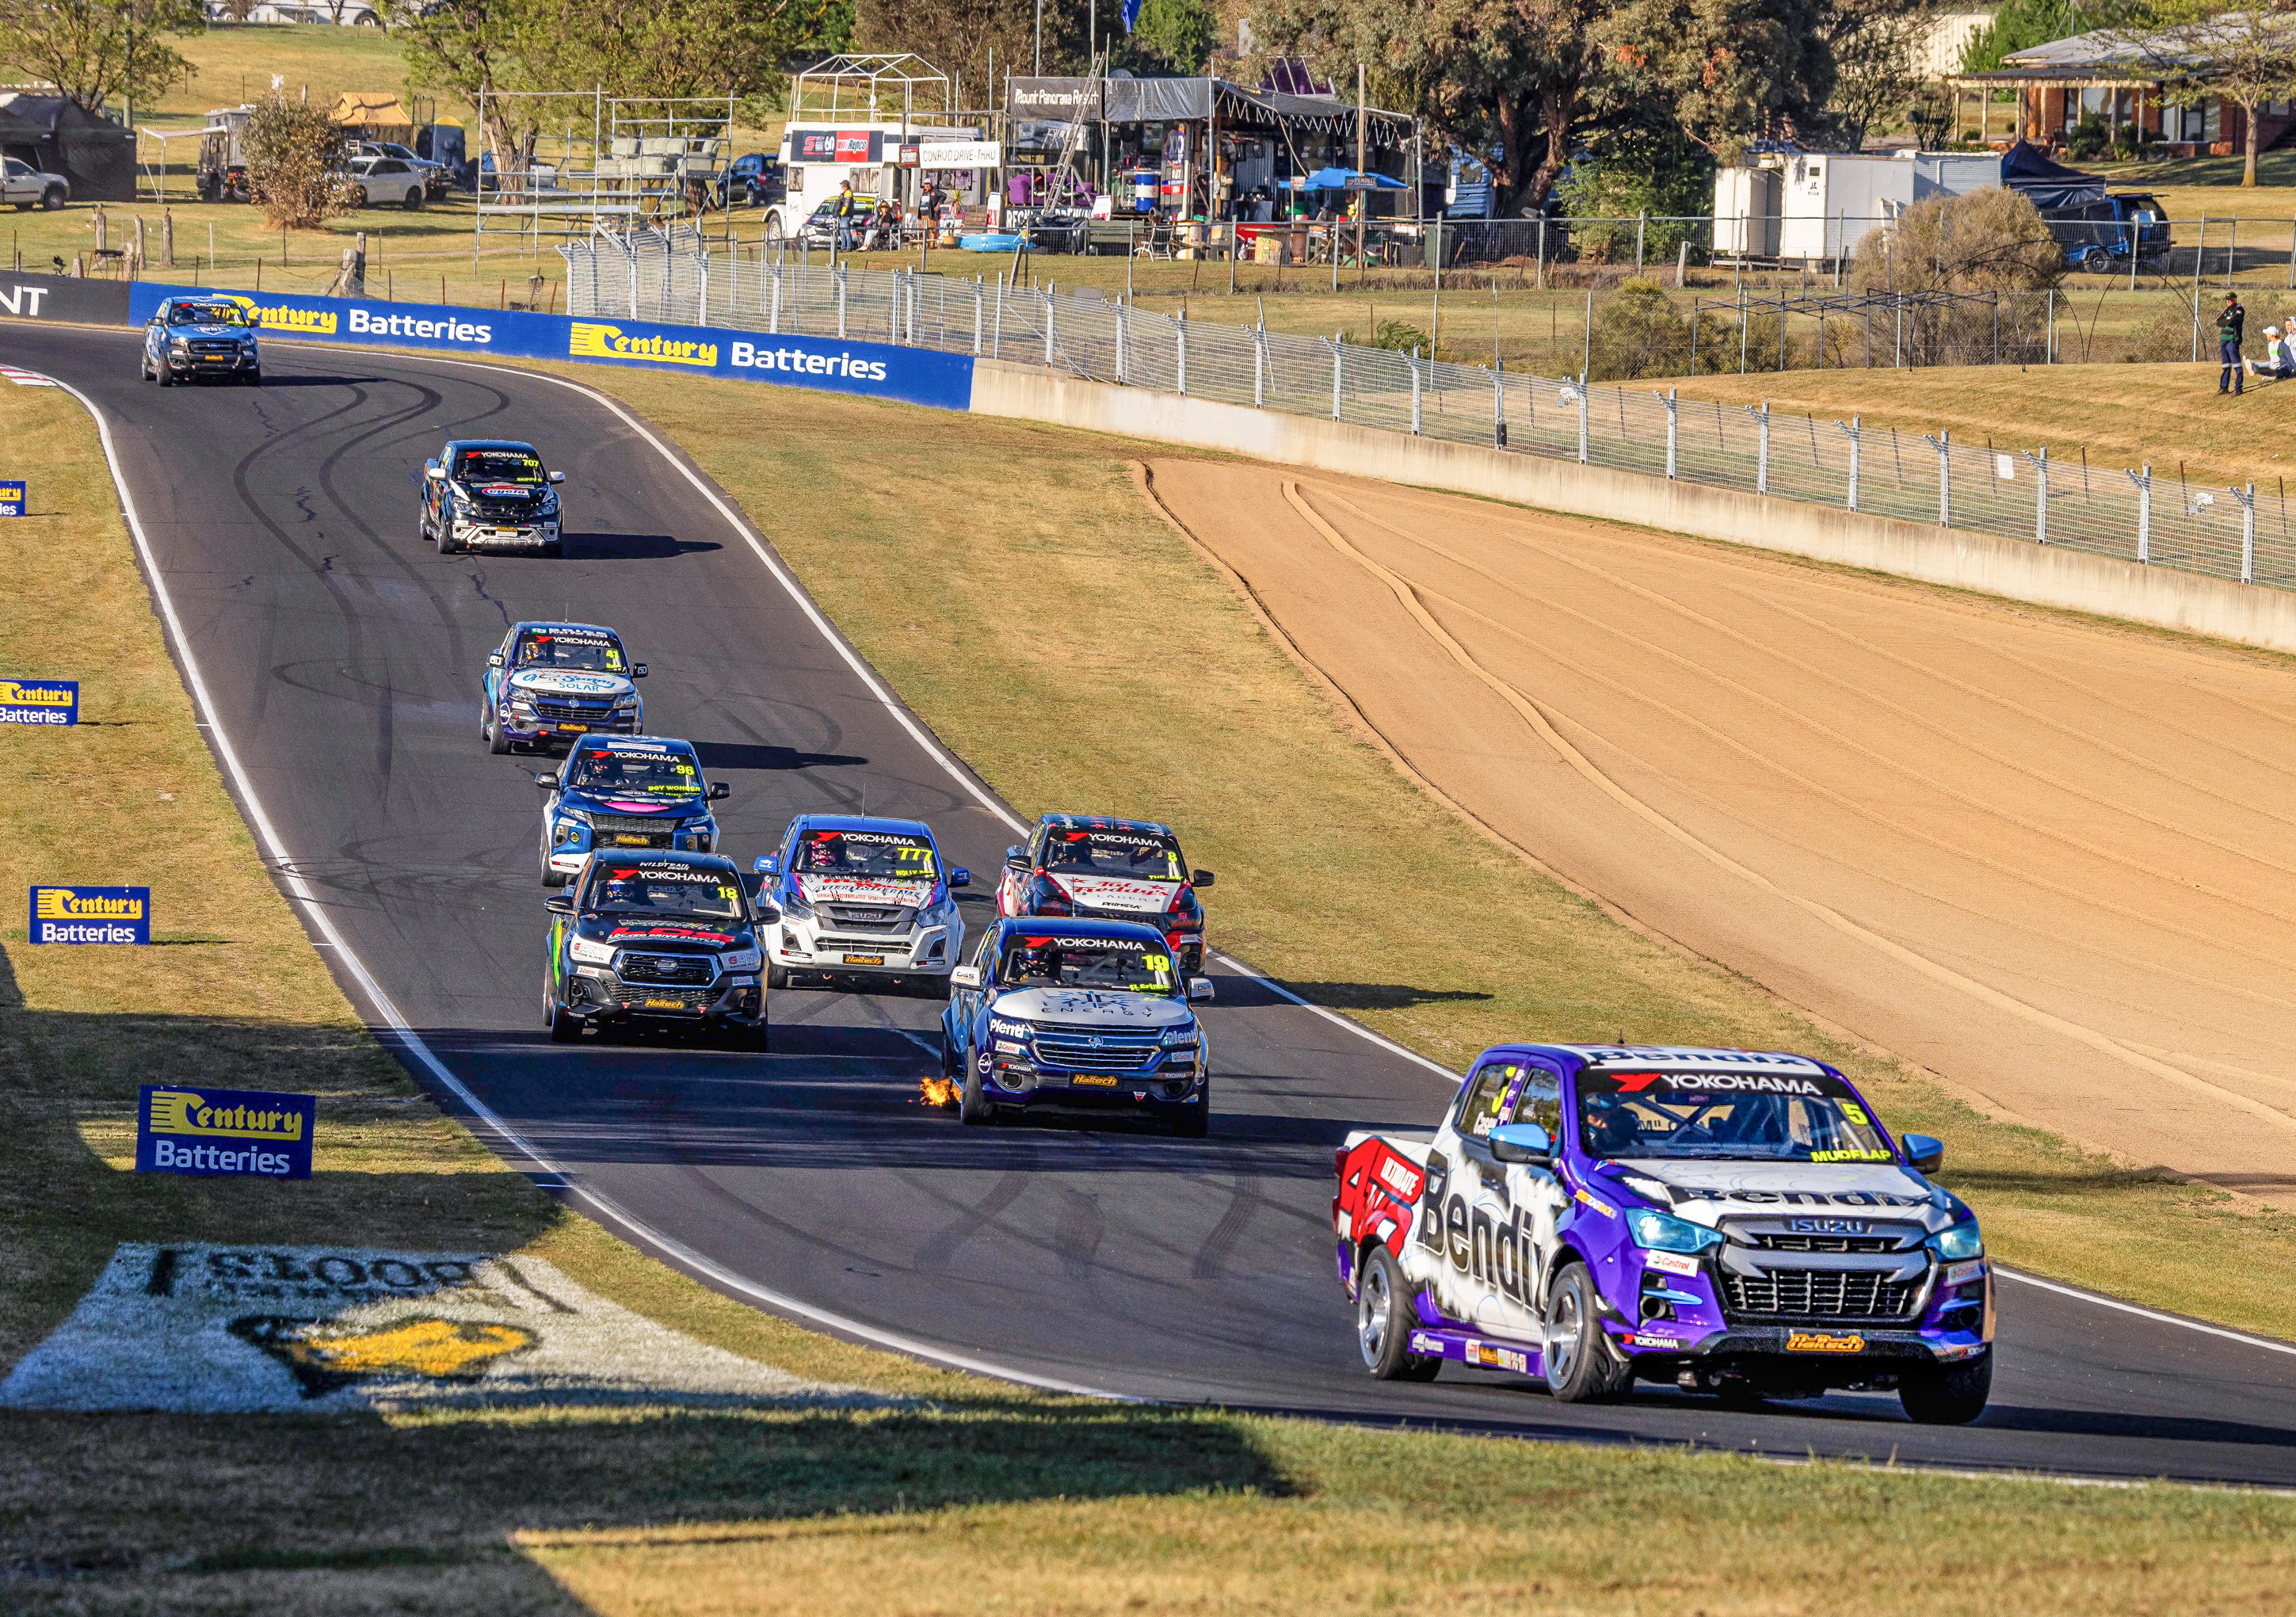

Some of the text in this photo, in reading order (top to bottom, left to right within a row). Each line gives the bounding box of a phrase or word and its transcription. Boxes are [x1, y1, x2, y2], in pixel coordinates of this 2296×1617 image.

[1015, 88, 1039, 105] Mount
[1039, 89, 1072, 105] Panorama
[349, 310, 490, 344] Batteries
[570, 322, 887, 381] Century Batteries
[554, 636, 611, 647] YOKOHAMA
[559, 683, 599, 692] SOLAR
[0, 707, 67, 724] Batteries
[613, 751, 680, 763] YOKOHAMA
[676, 765, 695, 776] 96
[616, 834, 649, 845] Haltech
[841, 833, 916, 846] YOKOHAMA
[1089, 833, 1163, 849] YOKOHAMA
[897, 847, 933, 862] 777
[1168, 852, 1178, 862] 8
[638, 871, 721, 884] YOKOHAMA
[717, 887, 738, 899] 18
[37, 889, 143, 919] Century
[42, 923, 135, 943] Batteries
[681, 935, 727, 945] SYSTEMS
[1054, 937, 1146, 951] YOKOHAMA
[1142, 955, 1170, 972] 19
[645, 998, 685, 1009] Haltech
[990, 1018, 1027, 1039] Plenti
[1002, 1043, 1016, 1052] Castrol
[1587, 1051, 1810, 1066] Bendix
[1008, 1063, 1032, 1073] YOKOHAMA
[1072, 1074, 1118, 1087] Haltech
[1661, 1074, 1823, 1096] YOKOHAMA
[151, 1091, 303, 1141] Century
[1841, 1103, 1868, 1125] 5
[155, 1139, 290, 1175] Batteries
[1810, 1149, 1892, 1162] MUDFLAP
[1380, 1156, 1419, 1196] ULTIMATE
[1791, 1218, 1862, 1234] ISUZU
[1661, 1257, 1690, 1272] Castrol
[1634, 1336, 1679, 1349] YOKOHAMA
[1787, 1333, 1865, 1353] Haltech
